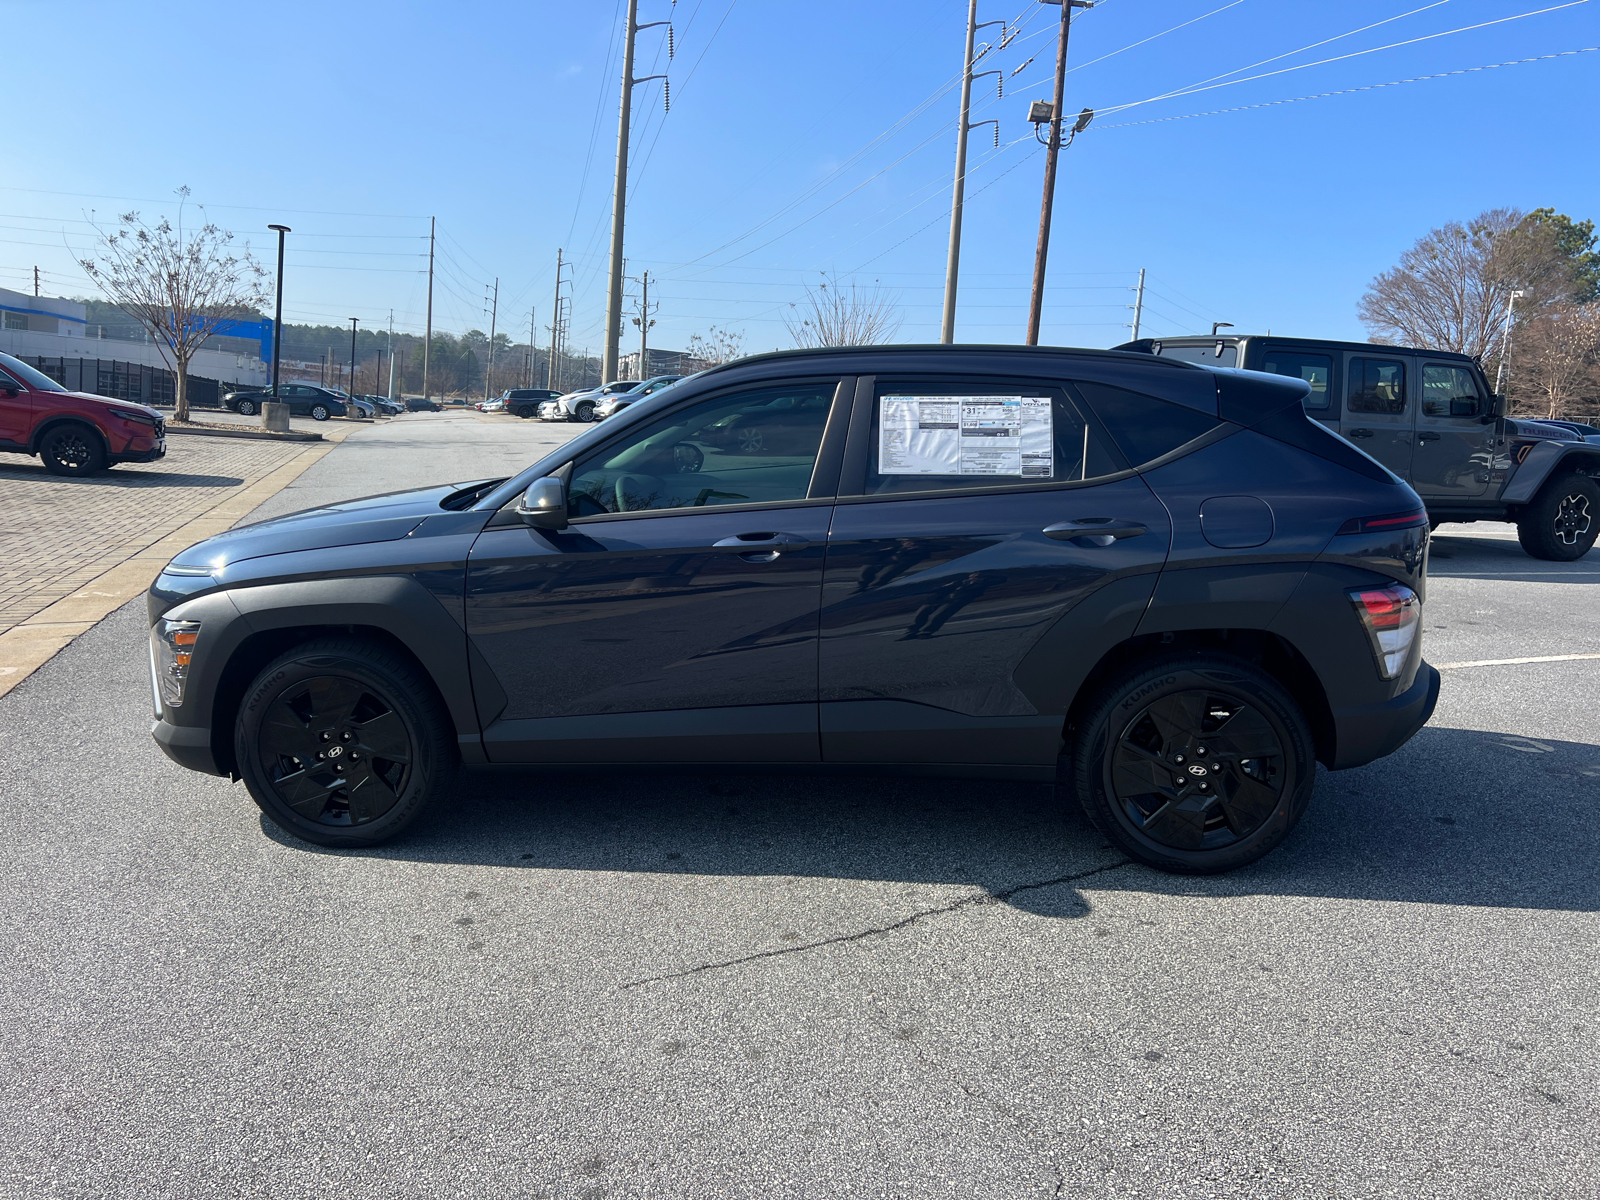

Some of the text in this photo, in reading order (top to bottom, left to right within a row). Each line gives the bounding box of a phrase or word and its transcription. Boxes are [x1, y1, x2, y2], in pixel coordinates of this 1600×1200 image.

[1522, 427, 1575, 440] RUBICON
[248, 671, 285, 712] KUMHO
[1121, 676, 1177, 711] KUMHO
[1257, 690, 1287, 718] PREMIUM
[388, 787, 422, 828] SOLUS
